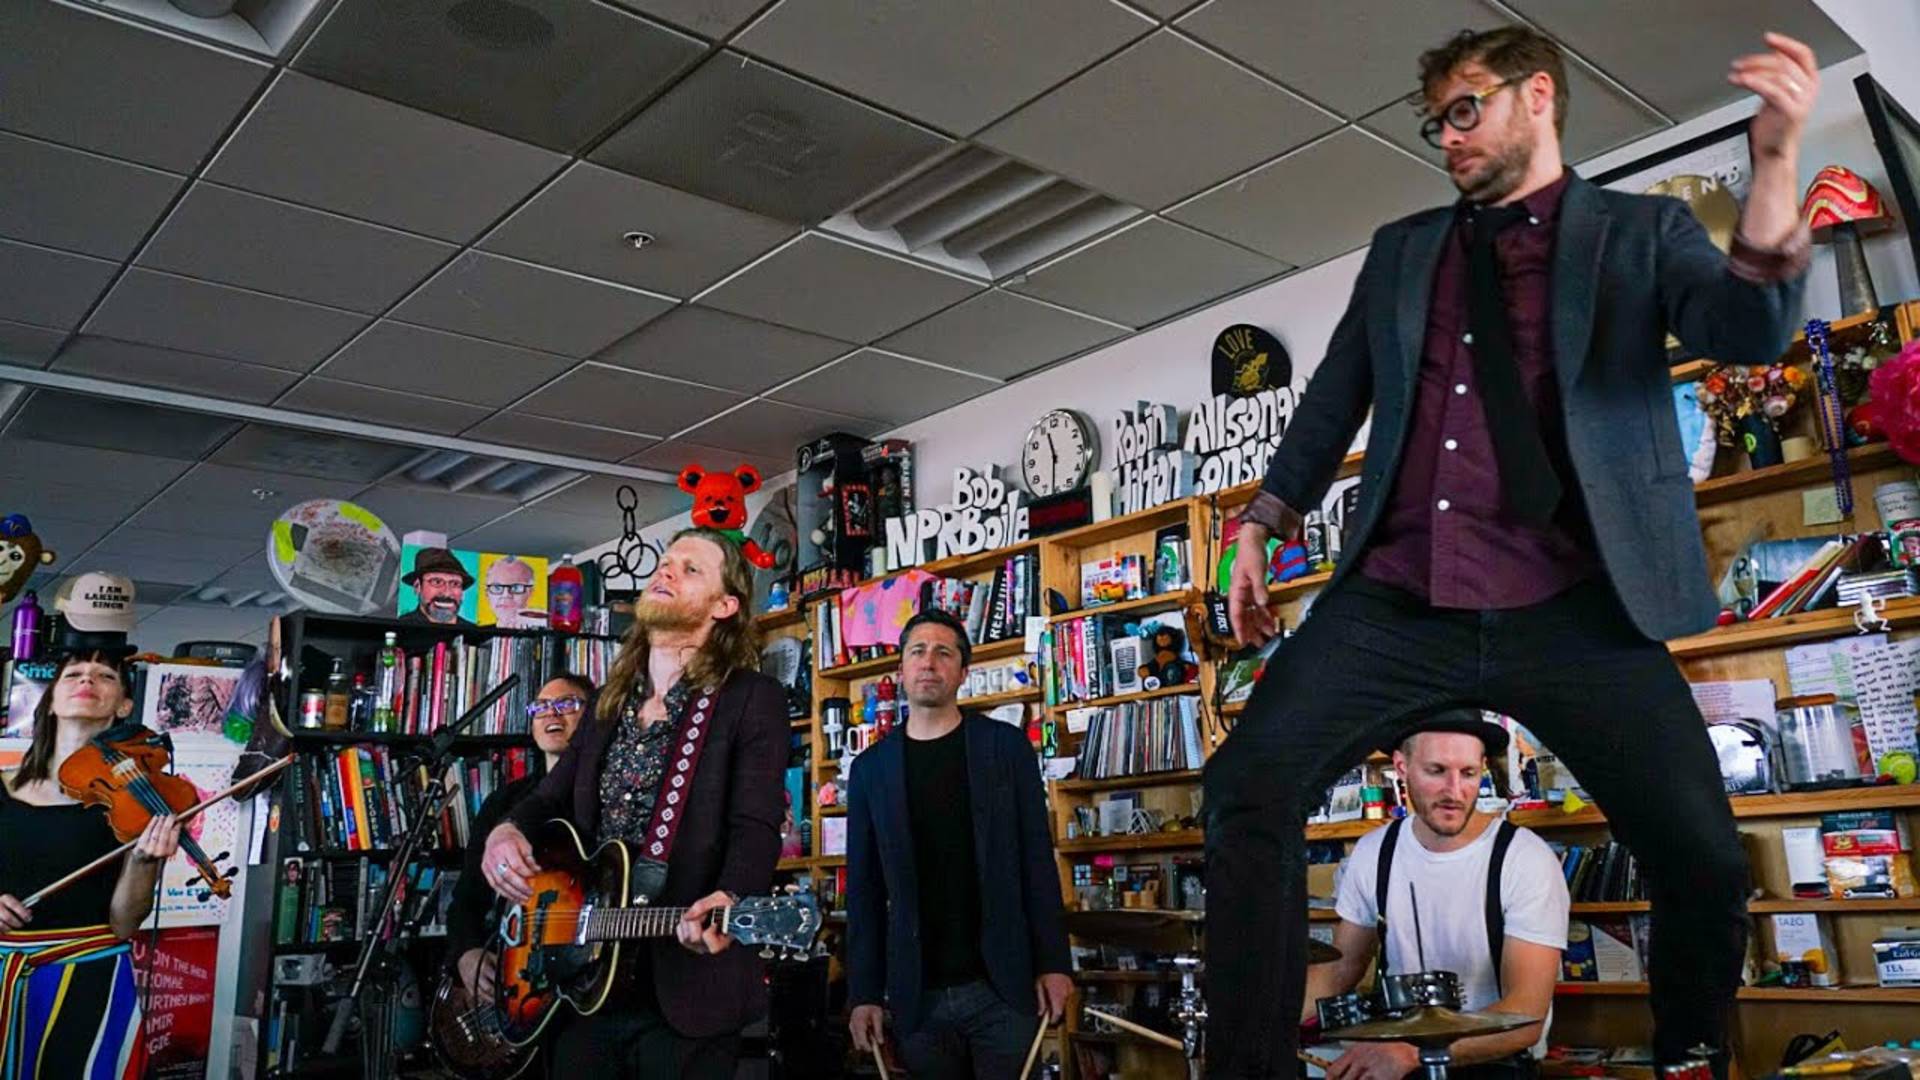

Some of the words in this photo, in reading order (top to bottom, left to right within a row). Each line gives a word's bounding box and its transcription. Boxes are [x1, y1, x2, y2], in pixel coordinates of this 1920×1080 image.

[1217, 329, 1254, 360] LOVE
[1112, 399, 1167, 472] Robin
[952, 463, 1005, 511] Bob
[1112, 449, 1183, 519] Hilton
[885, 501, 966, 572] NPR
